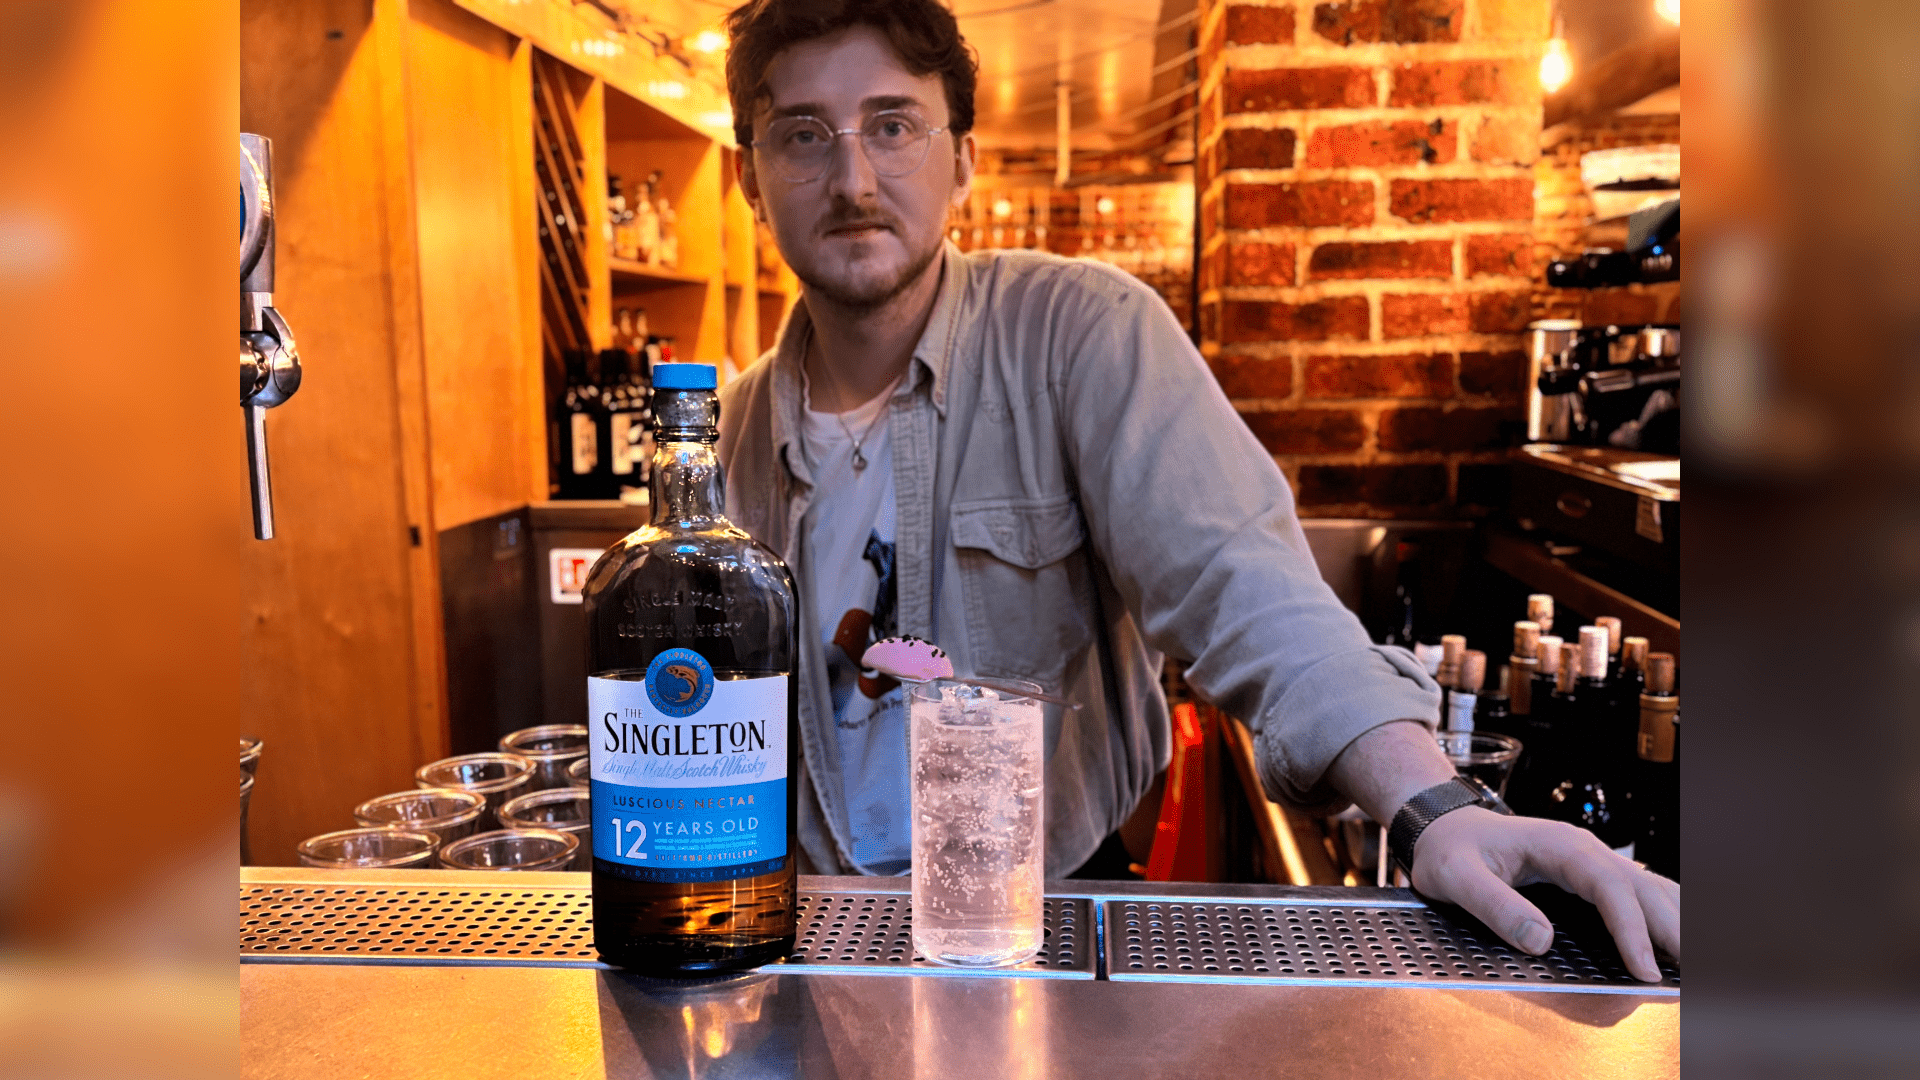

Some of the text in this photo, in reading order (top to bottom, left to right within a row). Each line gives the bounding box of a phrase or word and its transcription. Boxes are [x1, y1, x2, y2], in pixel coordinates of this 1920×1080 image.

[617, 622, 742, 638] SCOTCH WHISKY
[625, 707, 643, 719] THE
[604, 711, 767, 756] SINGLETON
[671, 757, 719, 780] Scotch
[718, 753, 768, 778] Whisky
[613, 794, 755, 810] LUSCIOUS NECTAR
[652, 817, 759, 836] YEARS OLD
[611, 817, 648, 860] 12
